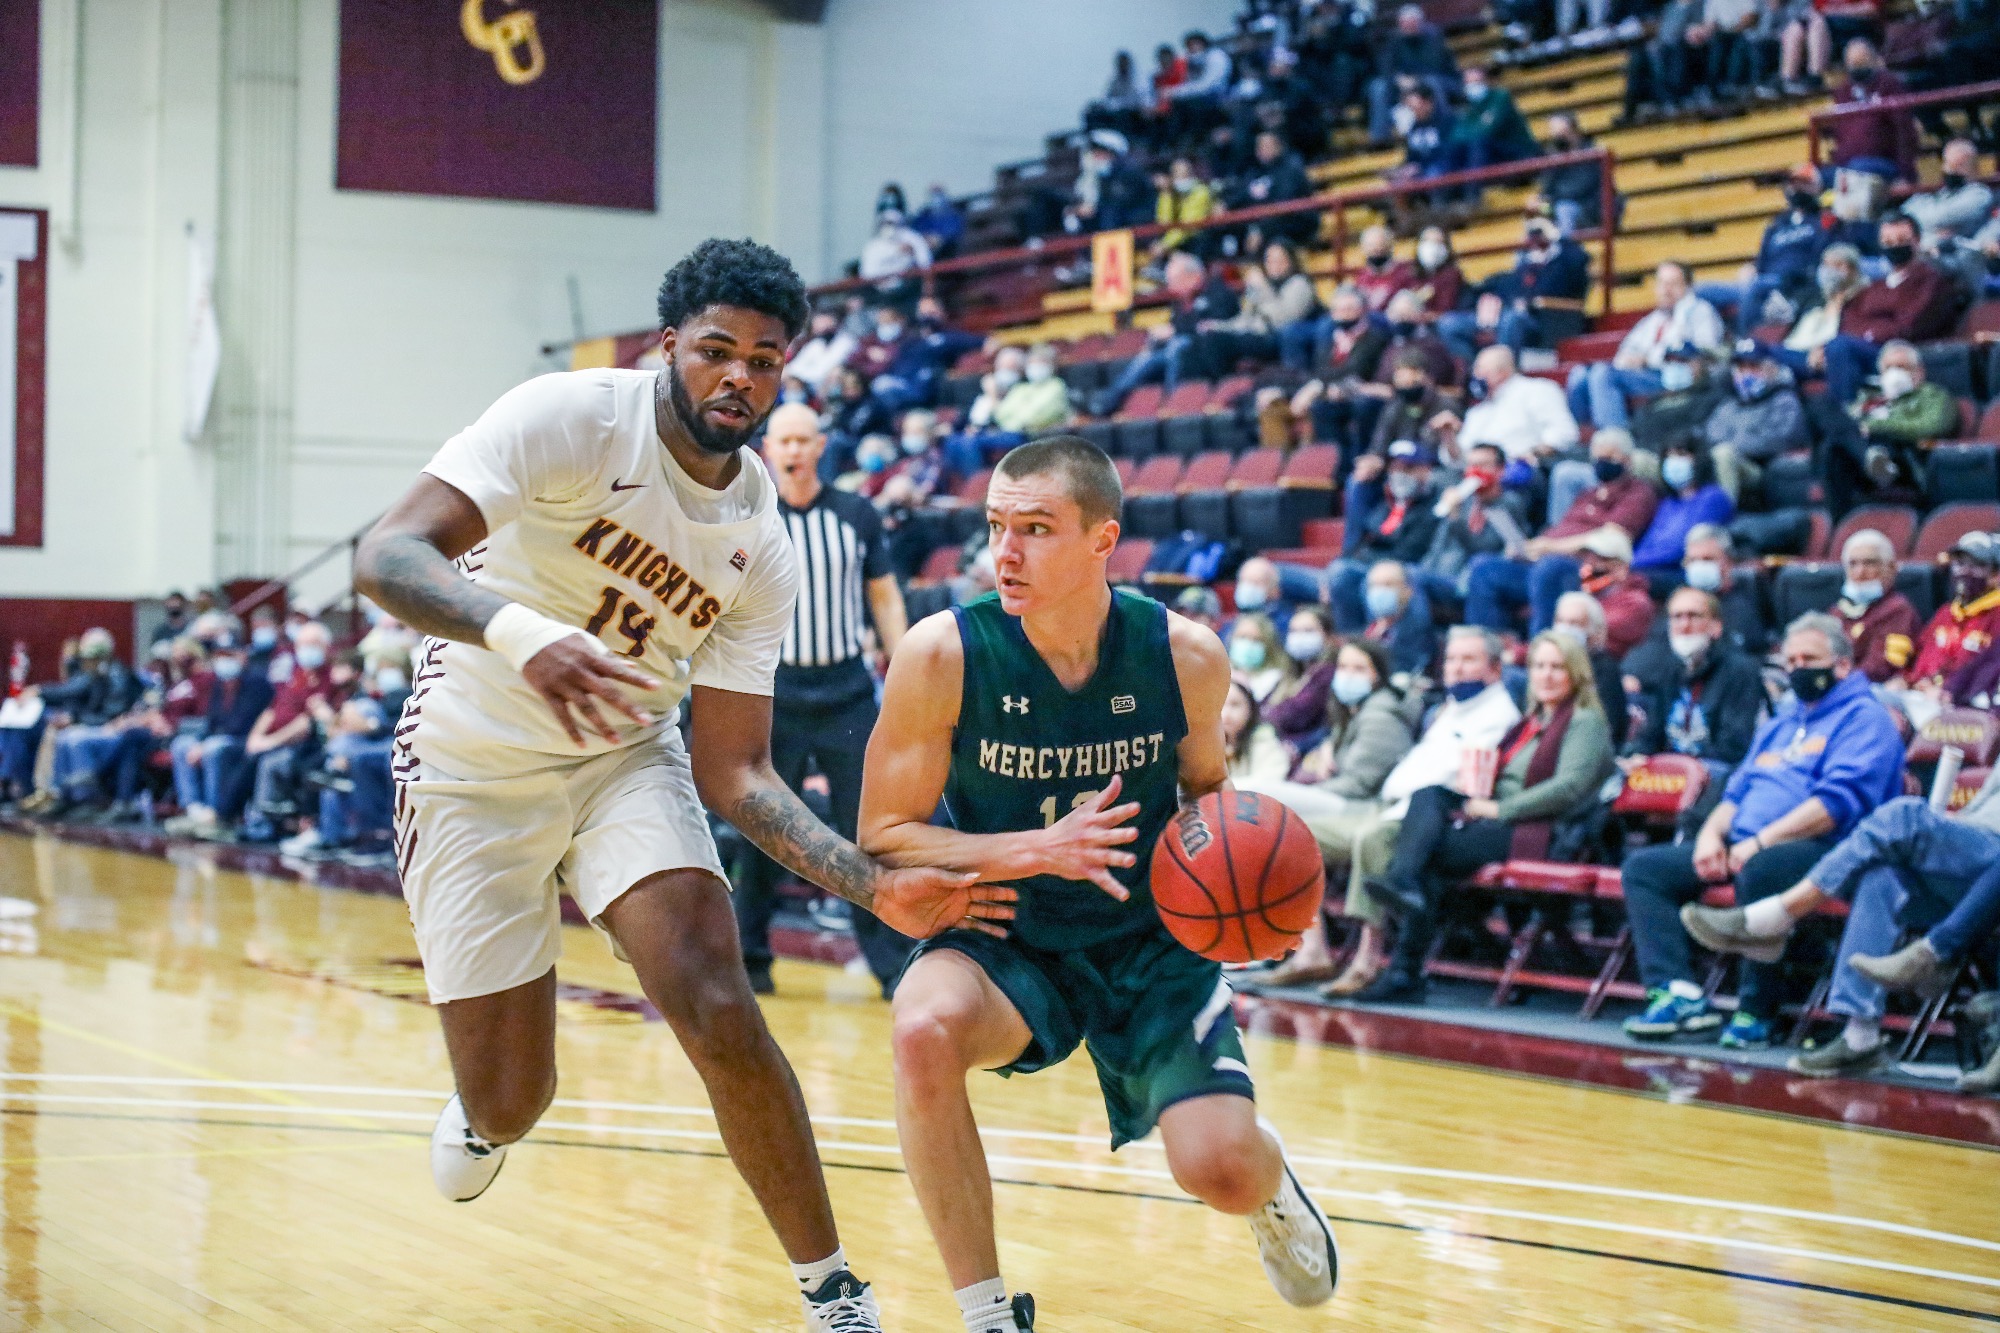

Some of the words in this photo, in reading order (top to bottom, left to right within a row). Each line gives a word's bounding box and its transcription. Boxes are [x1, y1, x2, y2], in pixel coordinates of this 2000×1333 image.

[1097, 245, 1128, 298] A
[572, 516, 722, 630] KNIGHTS
[585, 586, 655, 657] 14
[979, 733, 1164, 779] MERCYHURST
